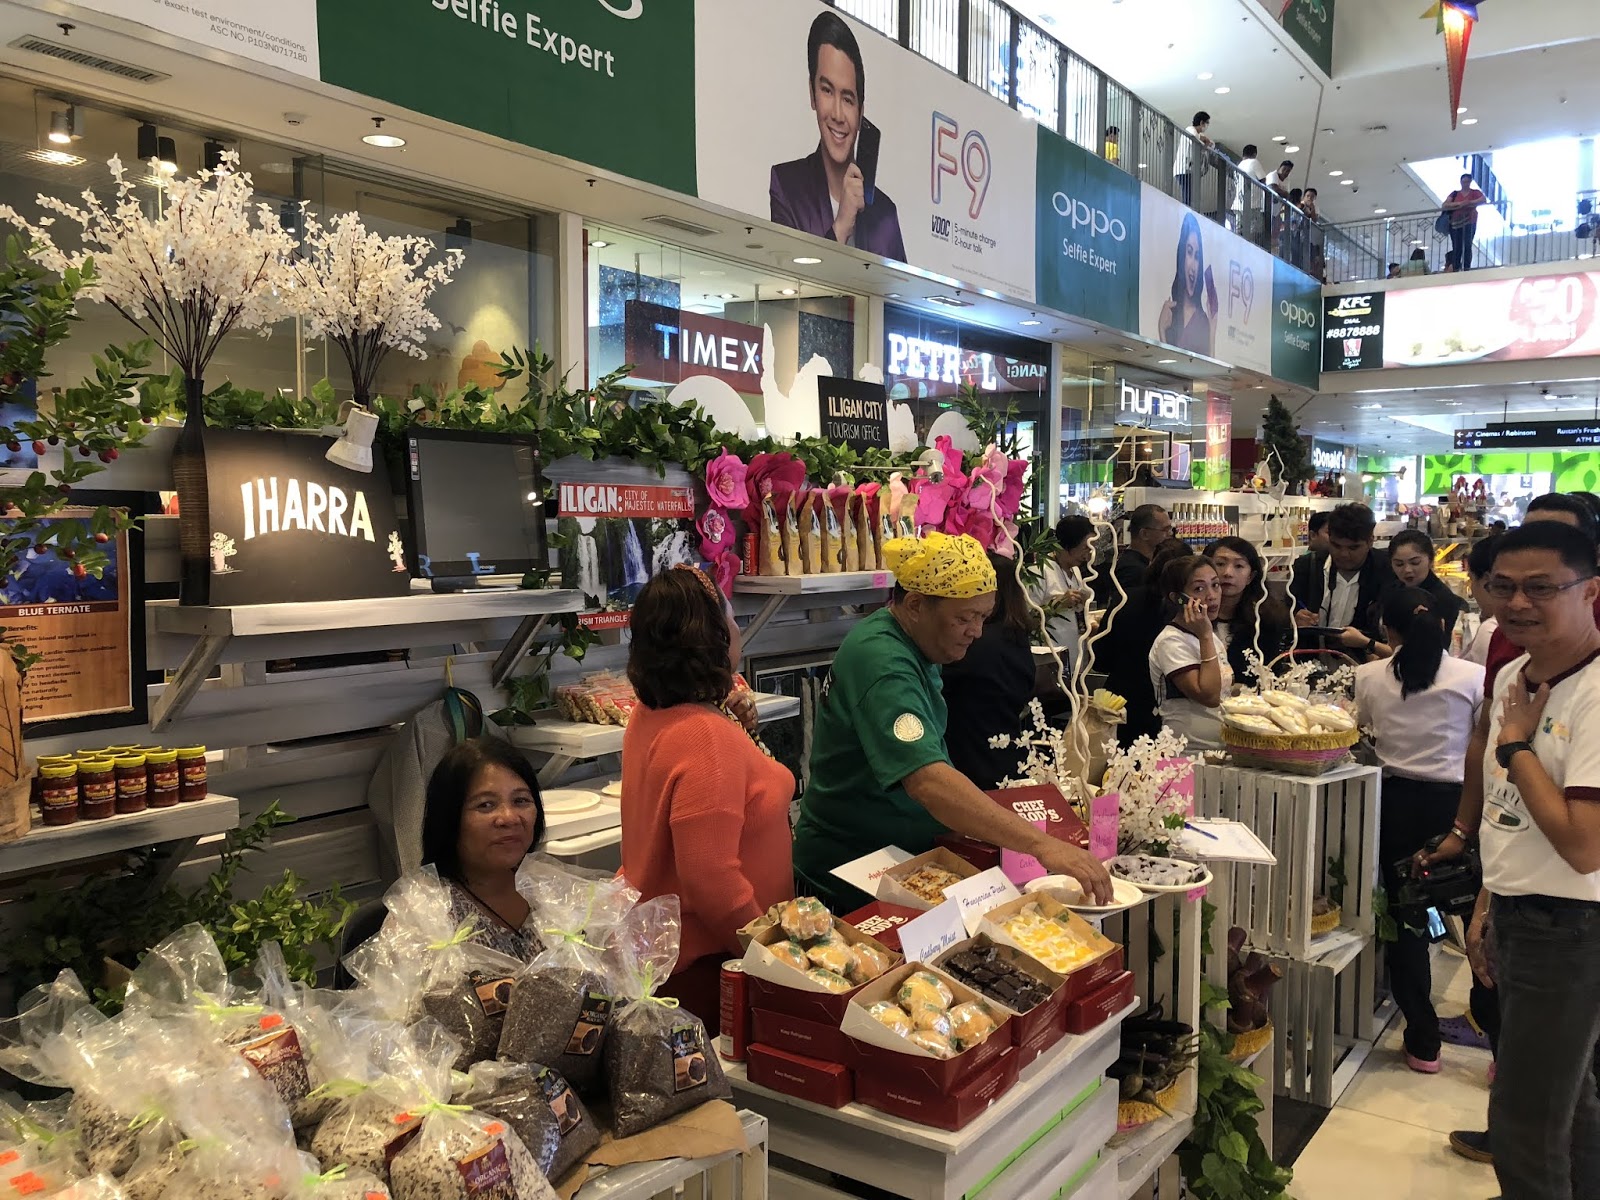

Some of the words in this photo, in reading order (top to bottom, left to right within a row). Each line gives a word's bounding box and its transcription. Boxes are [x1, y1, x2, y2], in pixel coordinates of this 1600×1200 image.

[164, 0, 190, 13] exact
[191, 6, 208, 19] test
[209, 13, 307, 52] environment/conditions.
[210, 24, 229, 37] ASC
[230, 30, 247, 43] NO.
[431, 0, 518, 39] elfie
[526, 13, 615, 78] Expert
[931, 110, 991, 220] F9
[1052, 191, 1127, 241] oppo
[954, 223, 978, 241] 5-minute
[979, 233, 997, 249] charge
[954, 236, 972, 251] 2-hour
[973, 244, 983, 255] talk
[1063, 238, 1088, 263] Selfie
[1089, 248, 1117, 275] Expert
[1228, 259, 1254, 325] F9
[1337, 296, 1372, 309] KFC
[1280, 300, 1316, 328] oppo
[1326, 325, 1380, 339] #8878888
[654, 322, 760, 374] TIMEX
[828, 396, 863, 418] ILIGAN
[863, 401, 883, 421] CITY
[1121, 378, 1188, 421] human
[827, 421, 860, 439] TOURISM
[861, 424, 882, 442] OFFICE
[1313, 447, 1346, 469] Donald's
[560, 485, 623, 513] ILIGAN:
[624, 489, 639, 500] CITY
[640, 490, 648, 501] OF
[624, 500, 655, 511] MAJESTIC
[657, 501, 692, 512] WATERFALLS
[240, 476, 376, 543] IHARRA
[18, 608, 44, 616] BLUE
[46, 605, 91, 614] TERNATE
[578, 616, 593, 625] RISM
[594, 614, 628, 624] TRIANGLE
[1012, 799, 1046, 813] CHEF
